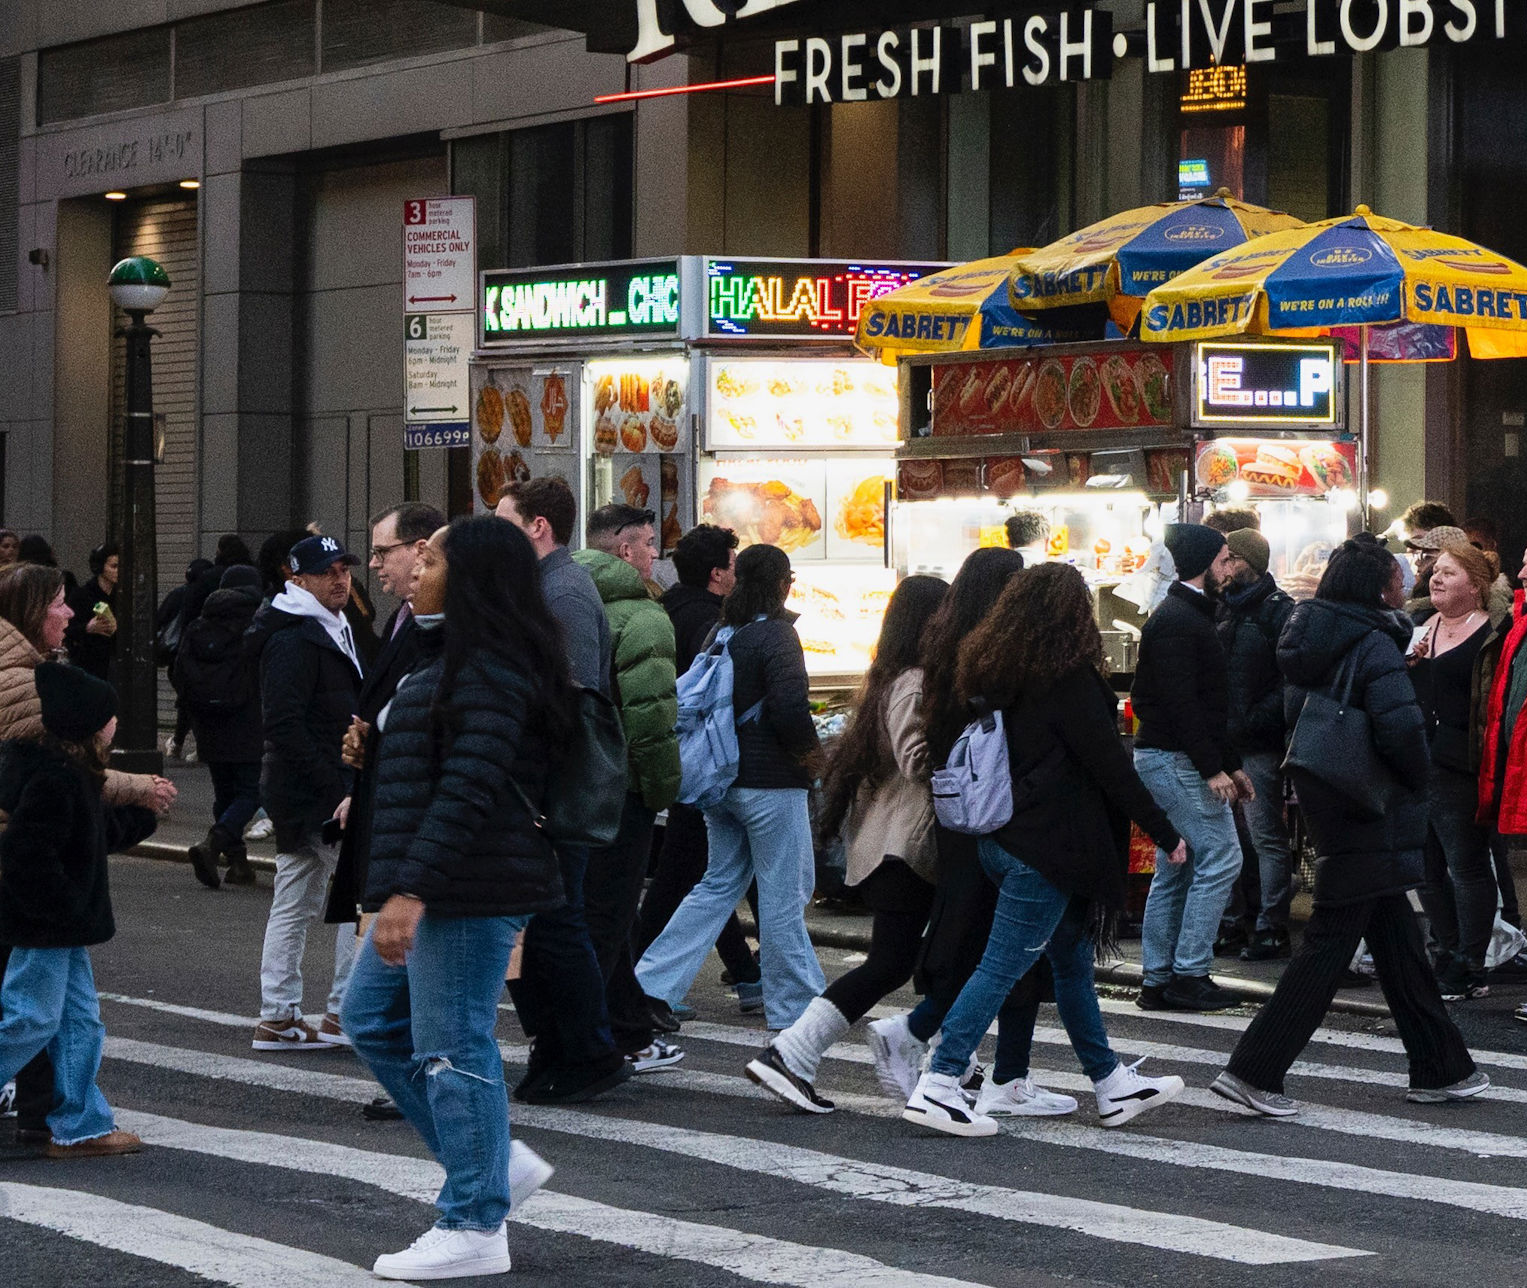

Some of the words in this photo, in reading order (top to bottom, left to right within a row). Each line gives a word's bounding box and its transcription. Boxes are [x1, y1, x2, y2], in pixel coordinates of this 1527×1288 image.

[774, 25, 942, 106] FRESH
[970, 10, 1093, 91] FISH
[410, 203, 421, 223] 3
[429, 218, 450, 226] parking
[407, 230, 461, 241] COMMERCIAL
[407, 244, 446, 254] VEHICLES
[449, 241, 470, 252] ONLY
[407, 260, 431, 269] Monday
[437, 259, 456, 268] Friday
[407, 270, 420, 278] 7am
[427, 270, 442, 280] 6pm
[1132, 269, 1166, 282] WE'RE
[711, 277, 842, 319] HALAL
[1280, 300, 1315, 312] WE'RE
[1318, 299, 1335, 311] ON
[1336, 299, 1345, 309] A
[1347, 296, 1373, 308] ROLL
[502, 280, 606, 330] SANDWICH
[410, 318, 421, 339] 6
[866, 313, 973, 341] SABRETT
[429, 332, 451, 340] parking
[408, 347, 432, 355] Monday
[440, 345, 460, 355] Friday
[408, 357, 422, 366] 6pm
[429, 355, 457, 365] Midnight
[408, 372, 437, 381] Saturday
[408, 381, 422, 390] 8am
[429, 380, 457, 390] Midnight
